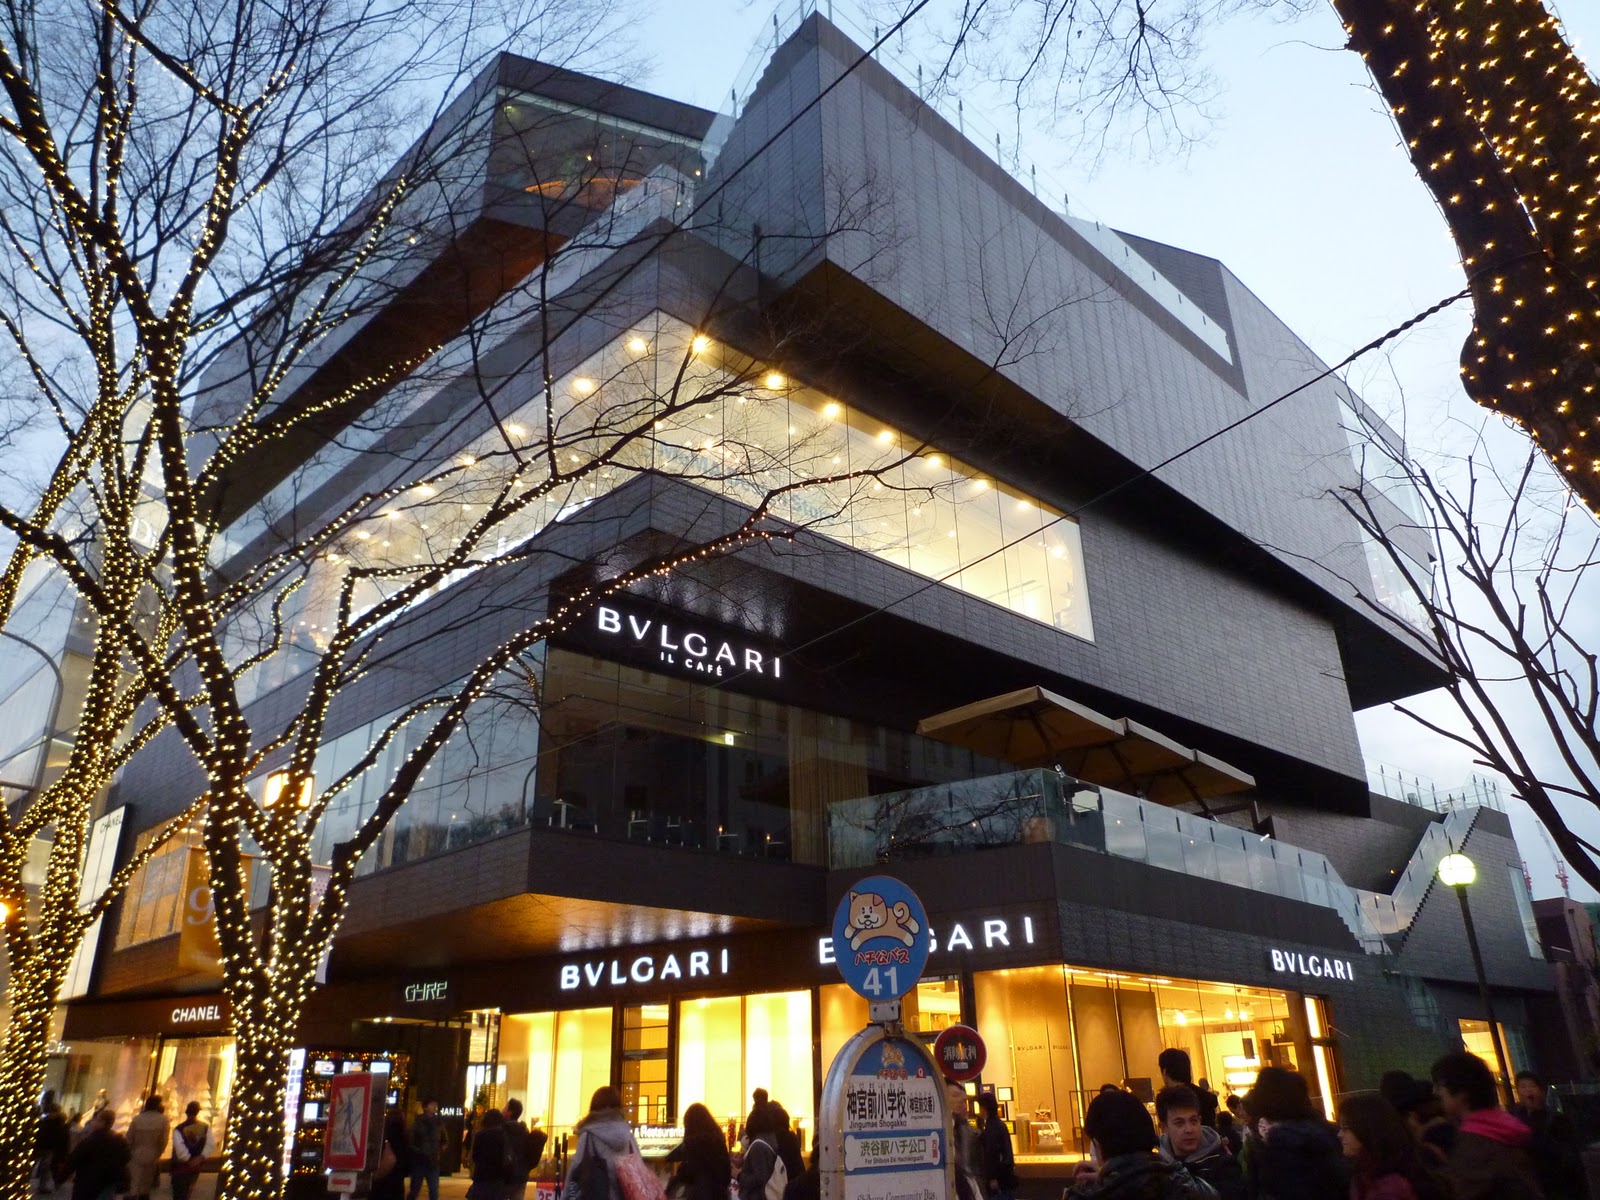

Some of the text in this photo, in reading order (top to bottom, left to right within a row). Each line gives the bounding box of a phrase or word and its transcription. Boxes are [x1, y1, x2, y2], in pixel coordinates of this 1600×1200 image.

[598, 606, 781, 678] BVLGARI
[660, 651, 723, 676] IL CAFÉ
[818, 915, 1034, 964] BARI
[560, 948, 728, 989] BVLGARI
[854, 947, 910, 966] ハチ公バス
[1271, 948, 1353, 981] BVLGARI
[863, 966, 898, 996] 41
[171, 1004, 221, 1022] CHANEL
[847, 1088, 907, 1120] 神宮前小学校
[849, 1119, 907, 1131] Jingumae Shogakko
[860, 1139, 927, 1157] 渋谷駅ハチ公口
